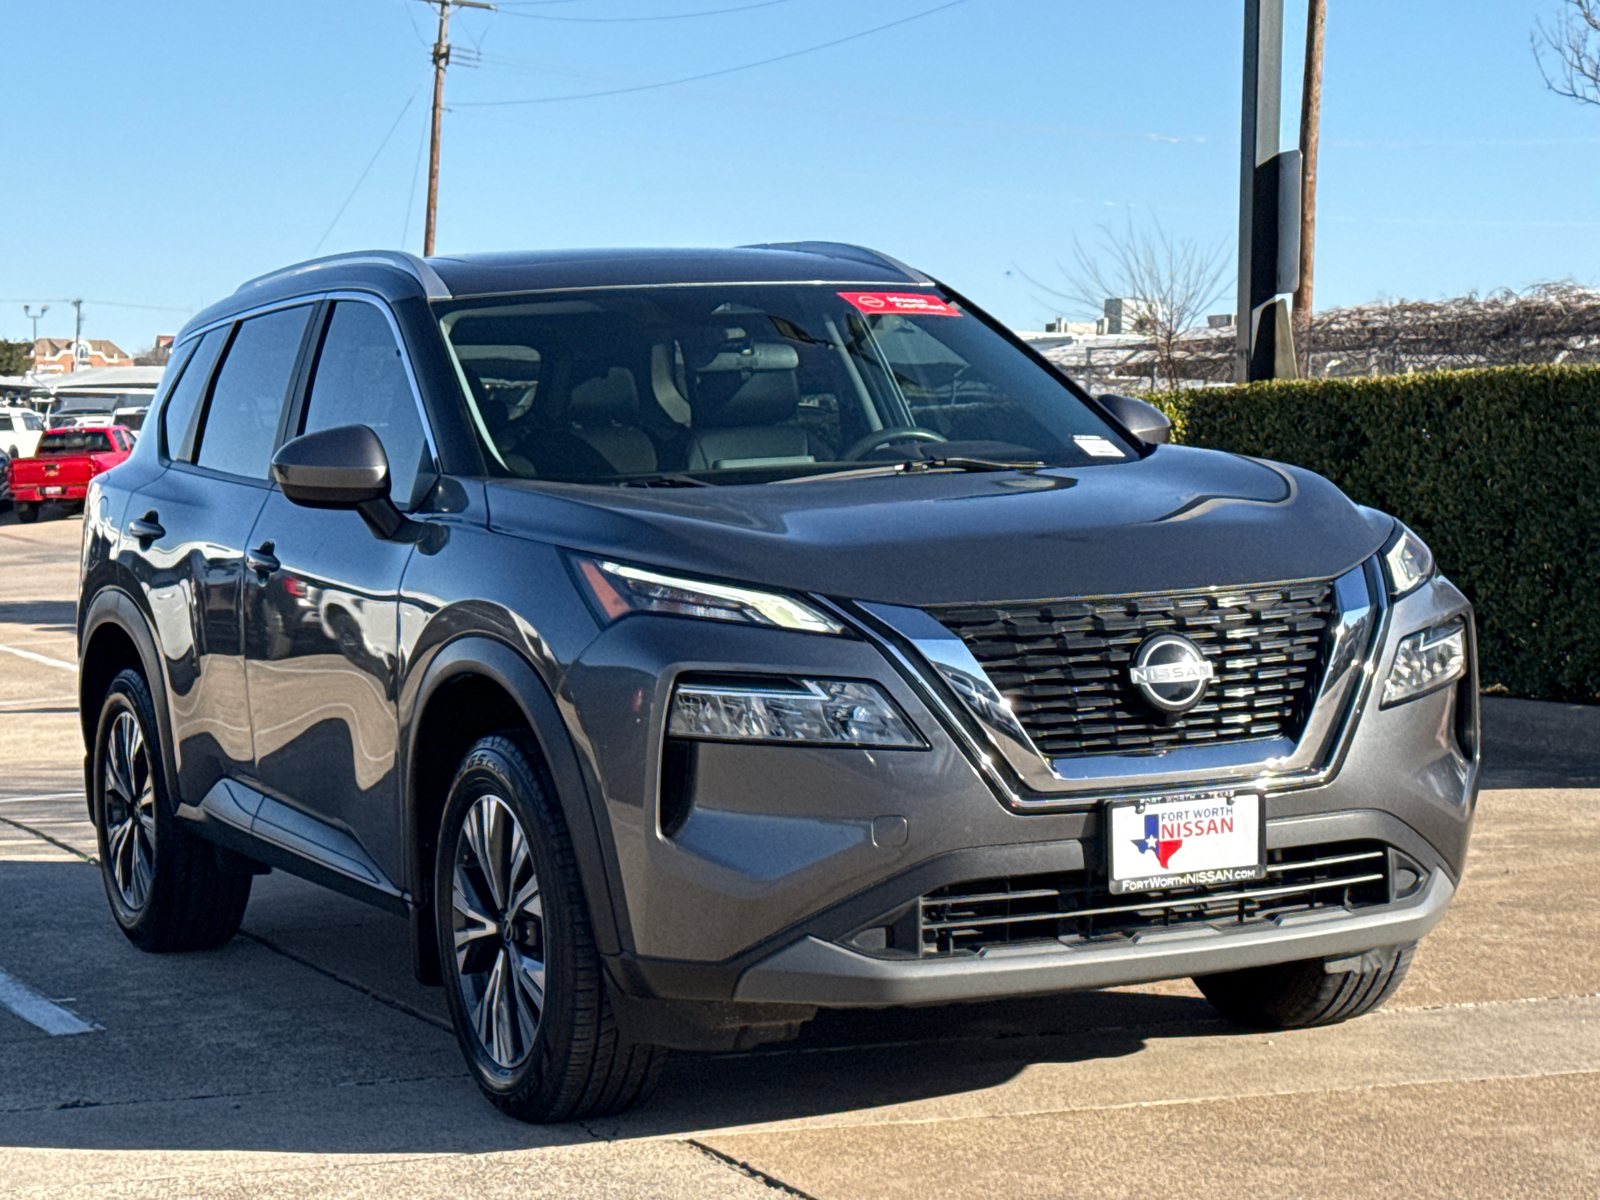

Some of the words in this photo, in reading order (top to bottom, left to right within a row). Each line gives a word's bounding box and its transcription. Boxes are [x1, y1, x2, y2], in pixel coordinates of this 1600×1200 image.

[1134, 665, 1210, 682] NISSAN
[1161, 810, 1190, 822] FORT
[1193, 806, 1234, 819] WORTH
[1161, 817, 1234, 840] NISSAN
